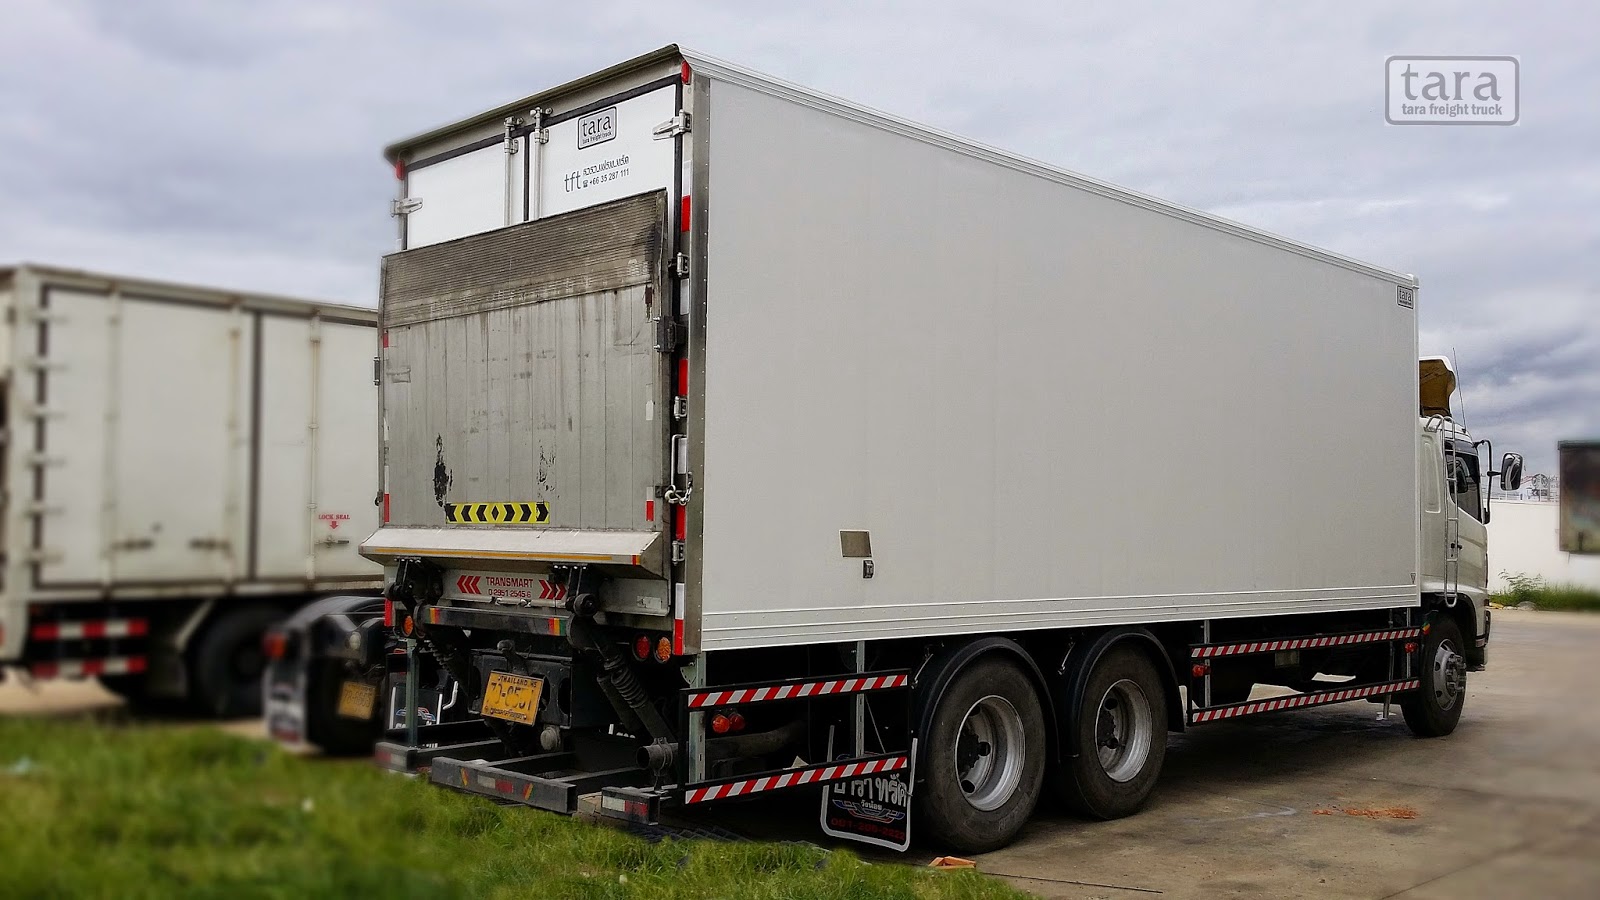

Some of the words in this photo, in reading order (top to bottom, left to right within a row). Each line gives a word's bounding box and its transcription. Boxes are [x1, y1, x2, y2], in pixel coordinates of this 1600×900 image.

[582, 116, 612, 136] tara
[620, 167, 629, 178] 111
[564, 170, 581, 192] tft
[486, 576, 534, 588] TRANSMART
